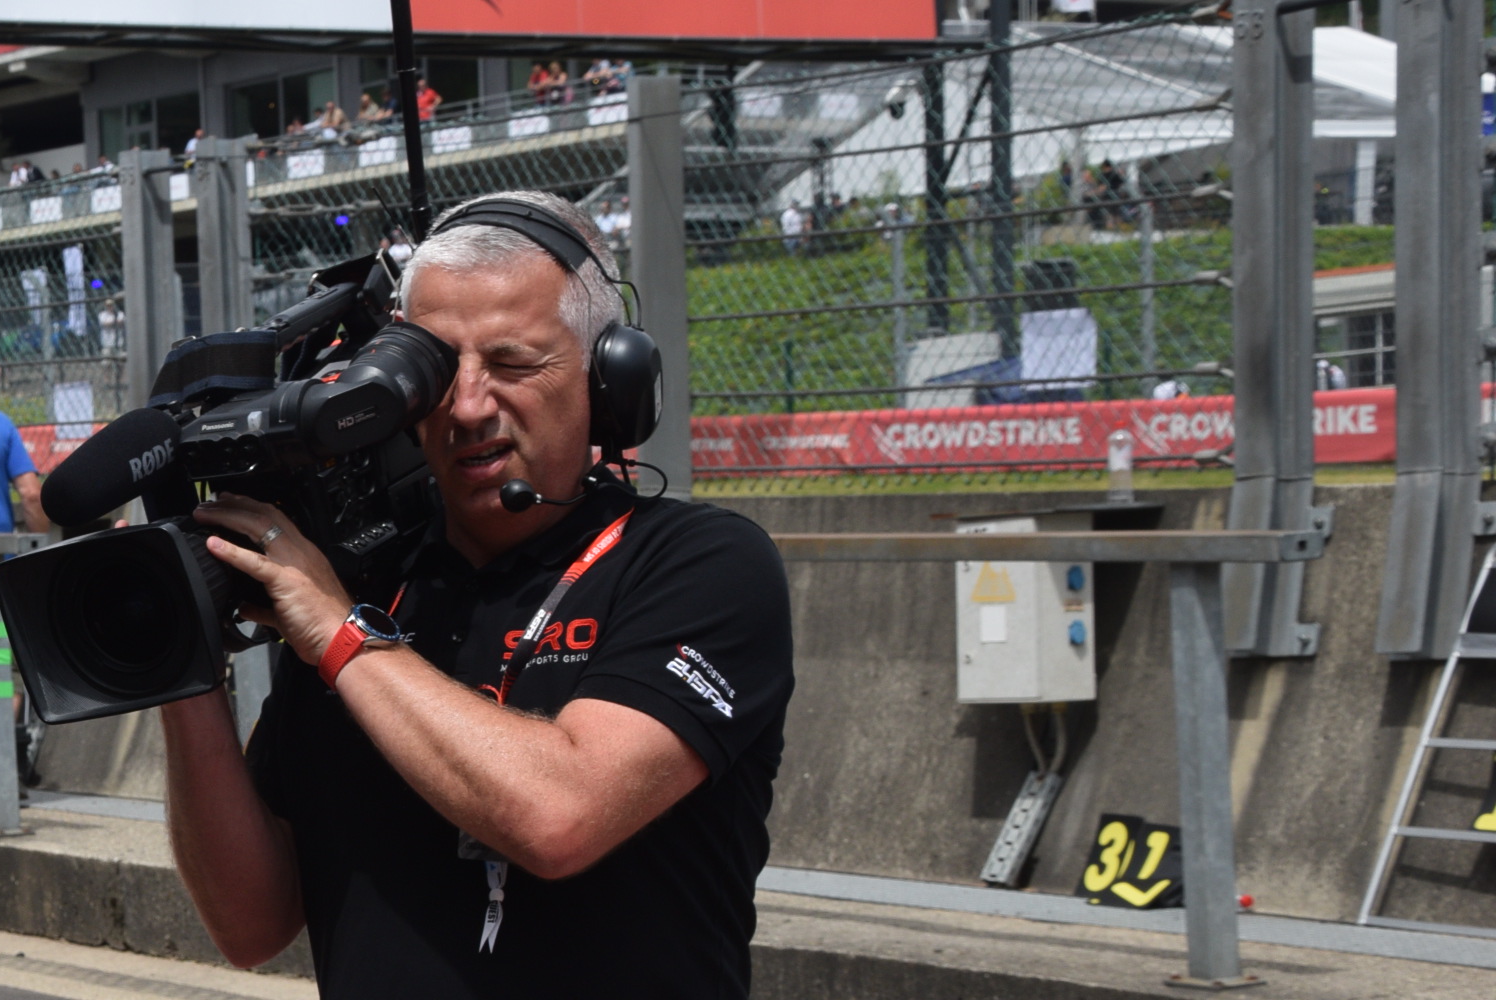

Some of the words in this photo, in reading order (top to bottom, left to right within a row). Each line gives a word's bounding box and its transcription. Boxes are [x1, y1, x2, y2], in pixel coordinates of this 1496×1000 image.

[201, 421, 235, 432] Panasonic
[338, 416, 355, 430] HD
[887, 416, 1082, 450] CROWDSTRIKE
[128, 438, 175, 483] RØDE
[681, 645, 736, 699] CROWDSTRIKE
